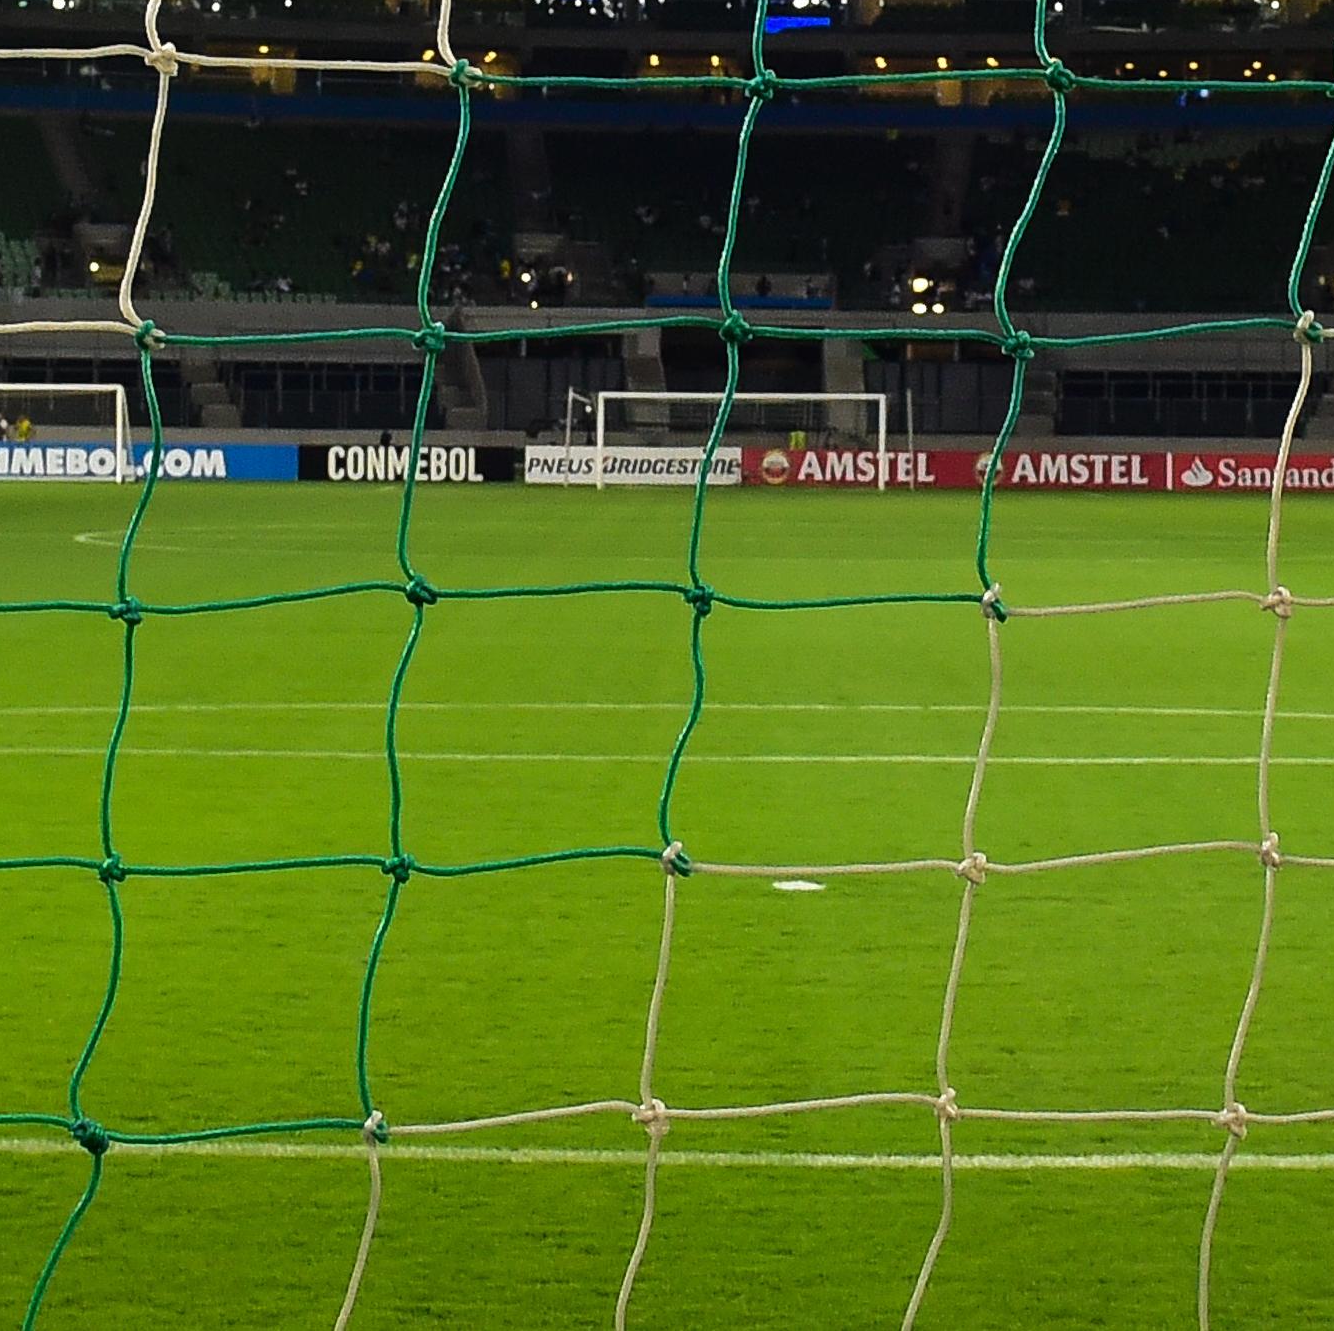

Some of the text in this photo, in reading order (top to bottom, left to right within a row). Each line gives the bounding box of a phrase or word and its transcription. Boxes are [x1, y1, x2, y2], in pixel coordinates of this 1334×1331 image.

[327, 445, 484, 482] CONMEBOL
[528, 457, 594, 475] PNEUS
[797, 450, 935, 483] AMSTEL
[1011, 453, 1149, 485] AMSTEL
